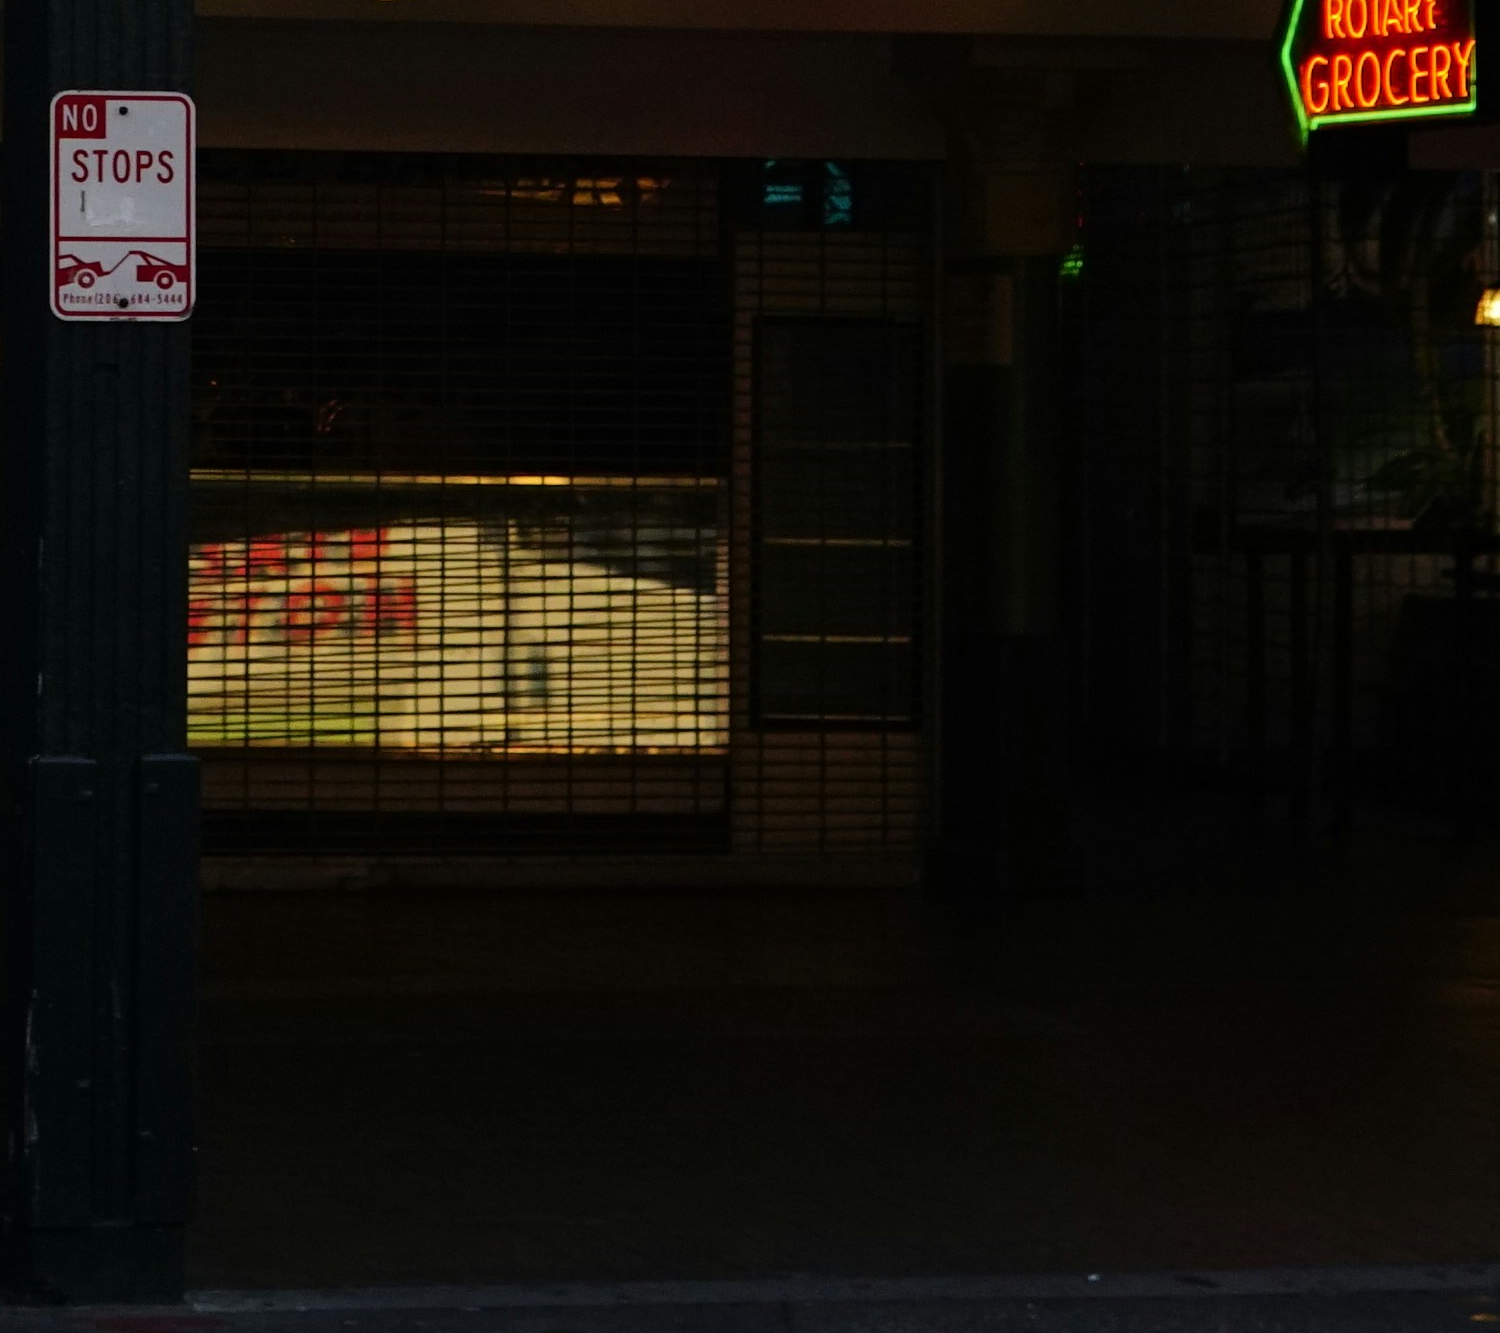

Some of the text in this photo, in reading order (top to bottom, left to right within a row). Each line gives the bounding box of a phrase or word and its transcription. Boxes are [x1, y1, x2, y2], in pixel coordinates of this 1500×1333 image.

[1302, 38, 1476, 114] GROCERY
[62, 103, 99, 133] NO
[72, 149, 175, 184] STOPS
